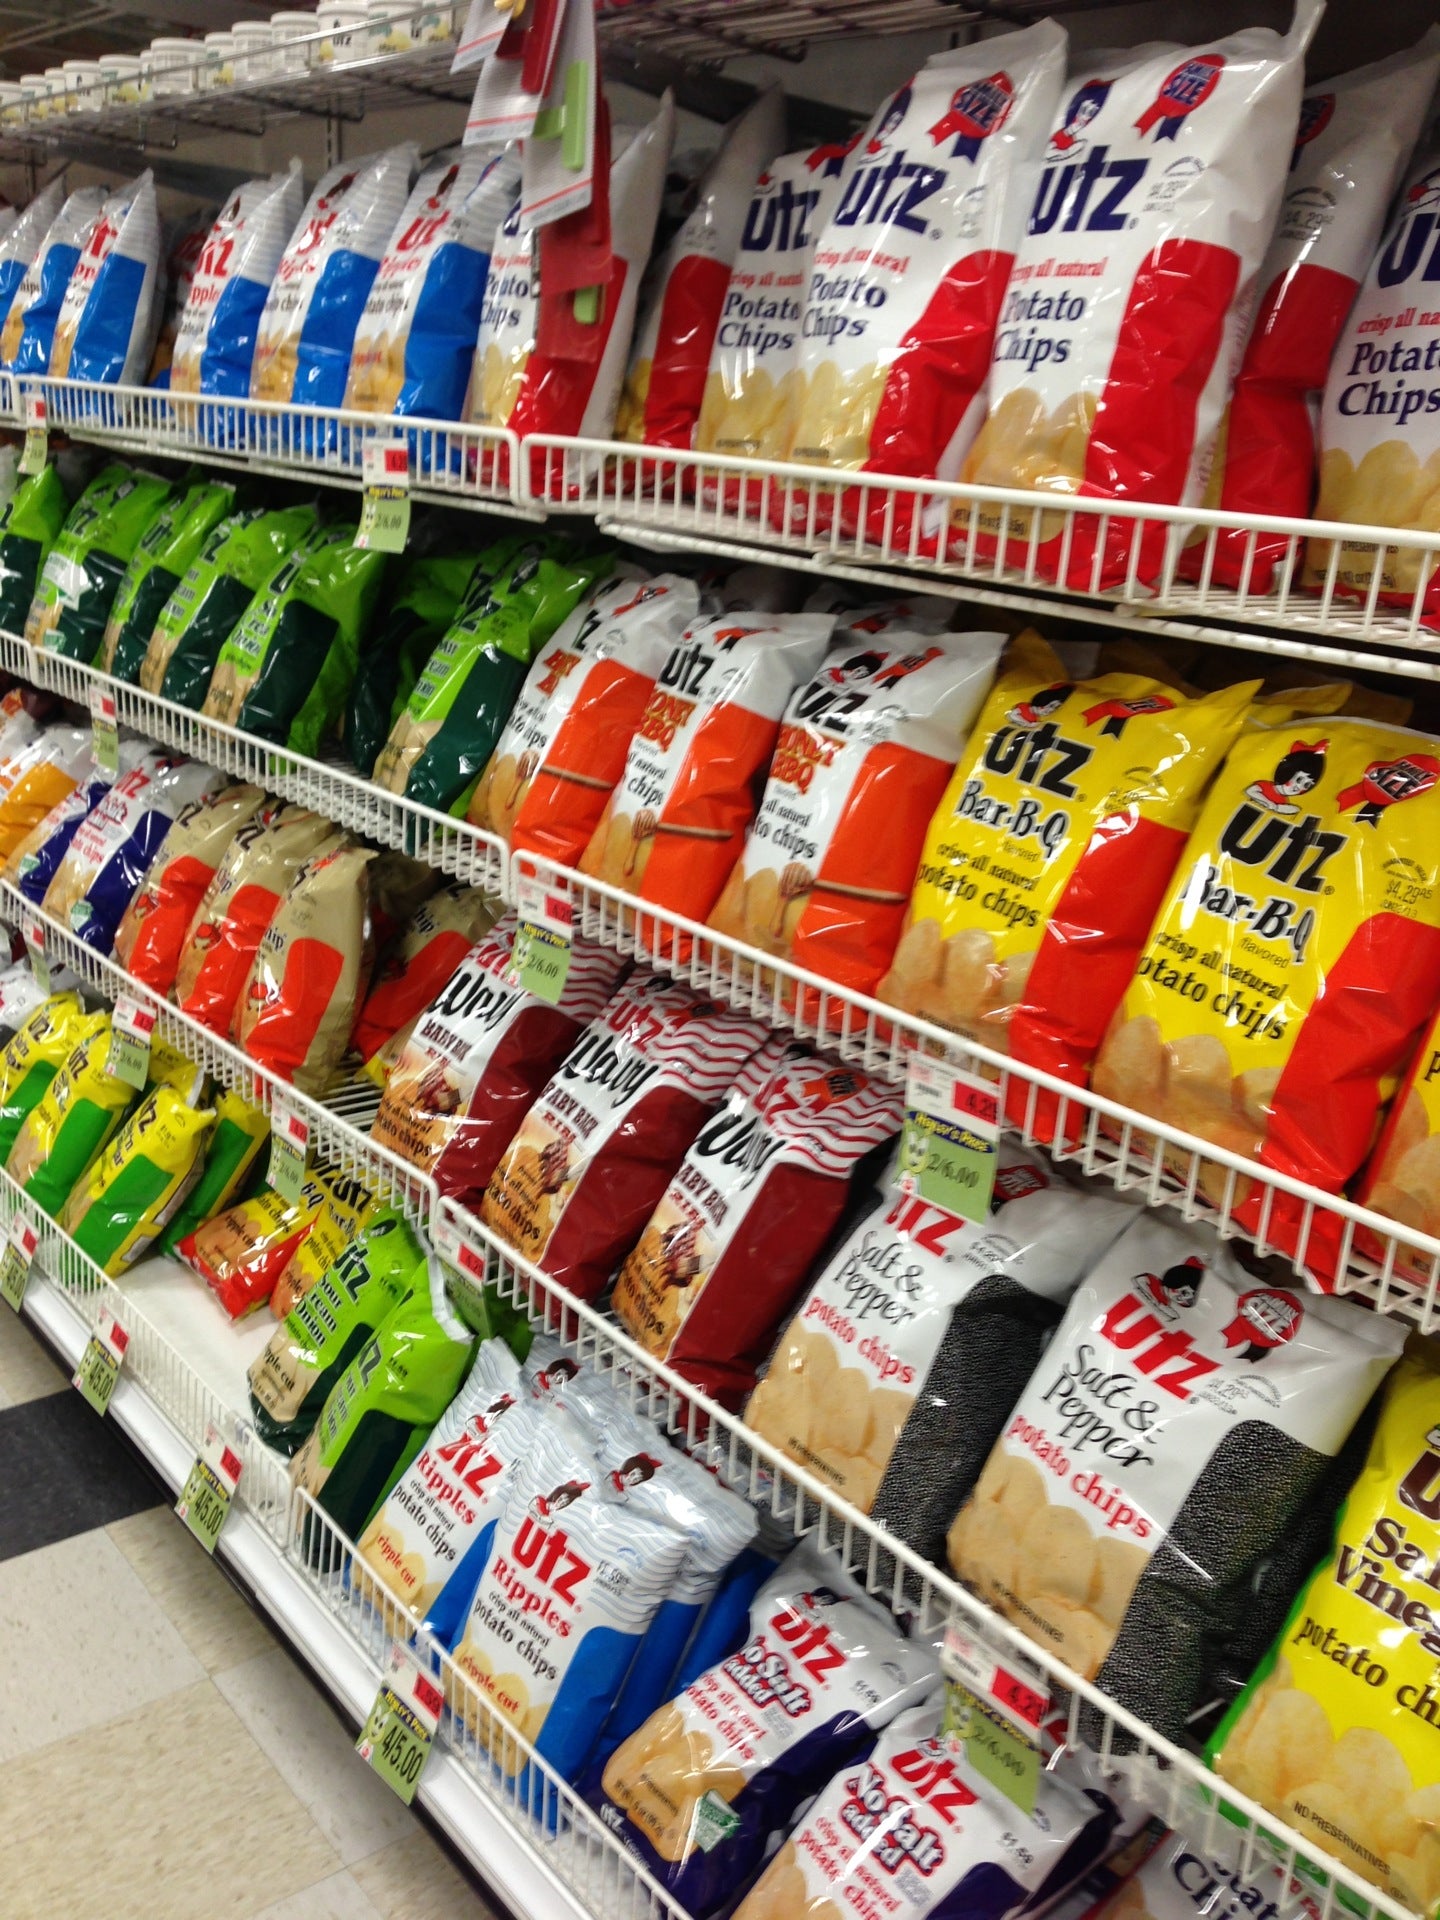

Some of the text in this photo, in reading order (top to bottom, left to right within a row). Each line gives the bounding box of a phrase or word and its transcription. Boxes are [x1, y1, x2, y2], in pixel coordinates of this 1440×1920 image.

[1163, 74, 1208, 105] SIZE
[718, 322, 795, 355] Chips
[803, 307, 868, 346] Chips
[994, 326, 1072, 373] Chips
[1347, 340, 1440, 376] Potat
[627, 775, 664, 808] chips
[772, 821, 818, 860] chips
[971, 854, 990, 871] all
[989, 862, 1041, 892] natural
[982, 886, 1040, 929] chips
[529, 954, 559, 979] 2/6.00
[1200, 951, 1222, 970] all
[1221, 961, 1290, 1000] natural
[1238, 937, 1291, 969] flavored
[1212, 990, 1289, 1040] chips
[927, 1153, 980, 1189] 2/6.00
[834, 1255, 918, 1326] Pepper
[803, 1296, 917, 1384] potato chips
[1062, 1344, 1165, 1444] Salt &
[1042, 1373, 1155, 1469] Pepper
[415, 1451, 478, 1526] Ripples
[1005, 1414, 1153, 1539] potato chips
[194, 1488, 224, 1536] 4/5.00
[391, 1484, 457, 1563] potato chips
[376, 1533, 416, 1588] ripple cut
[487, 1589, 508, 1612] crisp
[519, 1616, 551, 1648] natural
[491, 1555, 574, 1640] Ripples
[473, 1598, 558, 1682] potato chips
[1292, 1614, 1390, 1688] potato
[495, 1686, 521, 1715] cut
[757, 1650, 814, 1718] Salt
[382, 1724, 424, 1785] 4/5.00
[1293, 1799, 1391, 1877] NO PRESERVATIVES
